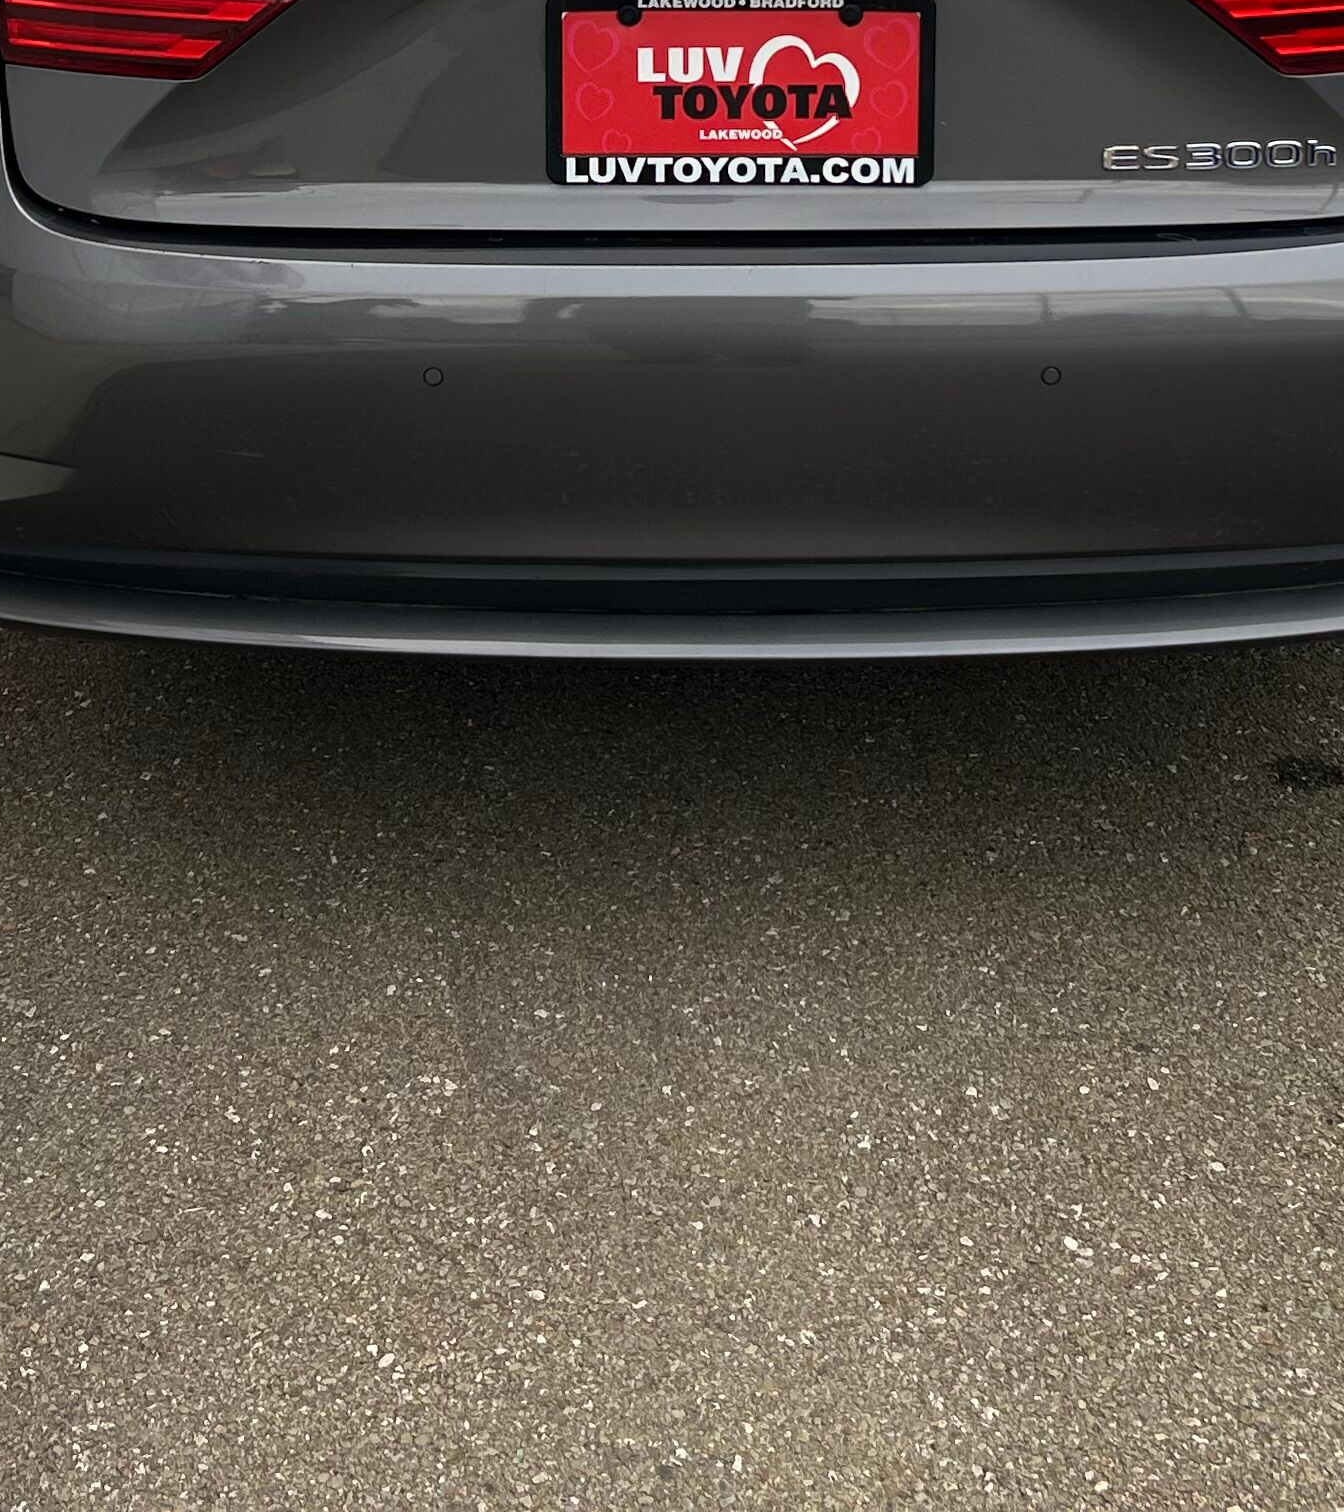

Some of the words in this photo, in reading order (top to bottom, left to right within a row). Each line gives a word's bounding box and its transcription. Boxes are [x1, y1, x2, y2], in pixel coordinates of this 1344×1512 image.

[636, 46, 744, 83] LUV
[652, 84, 852, 120] TOYOTA
[699, 129, 783, 140] LAKEWOOD
[1103, 139, 1338, 170] ES300h
[565, 157, 915, 184] LUVTOYOTA.COM
